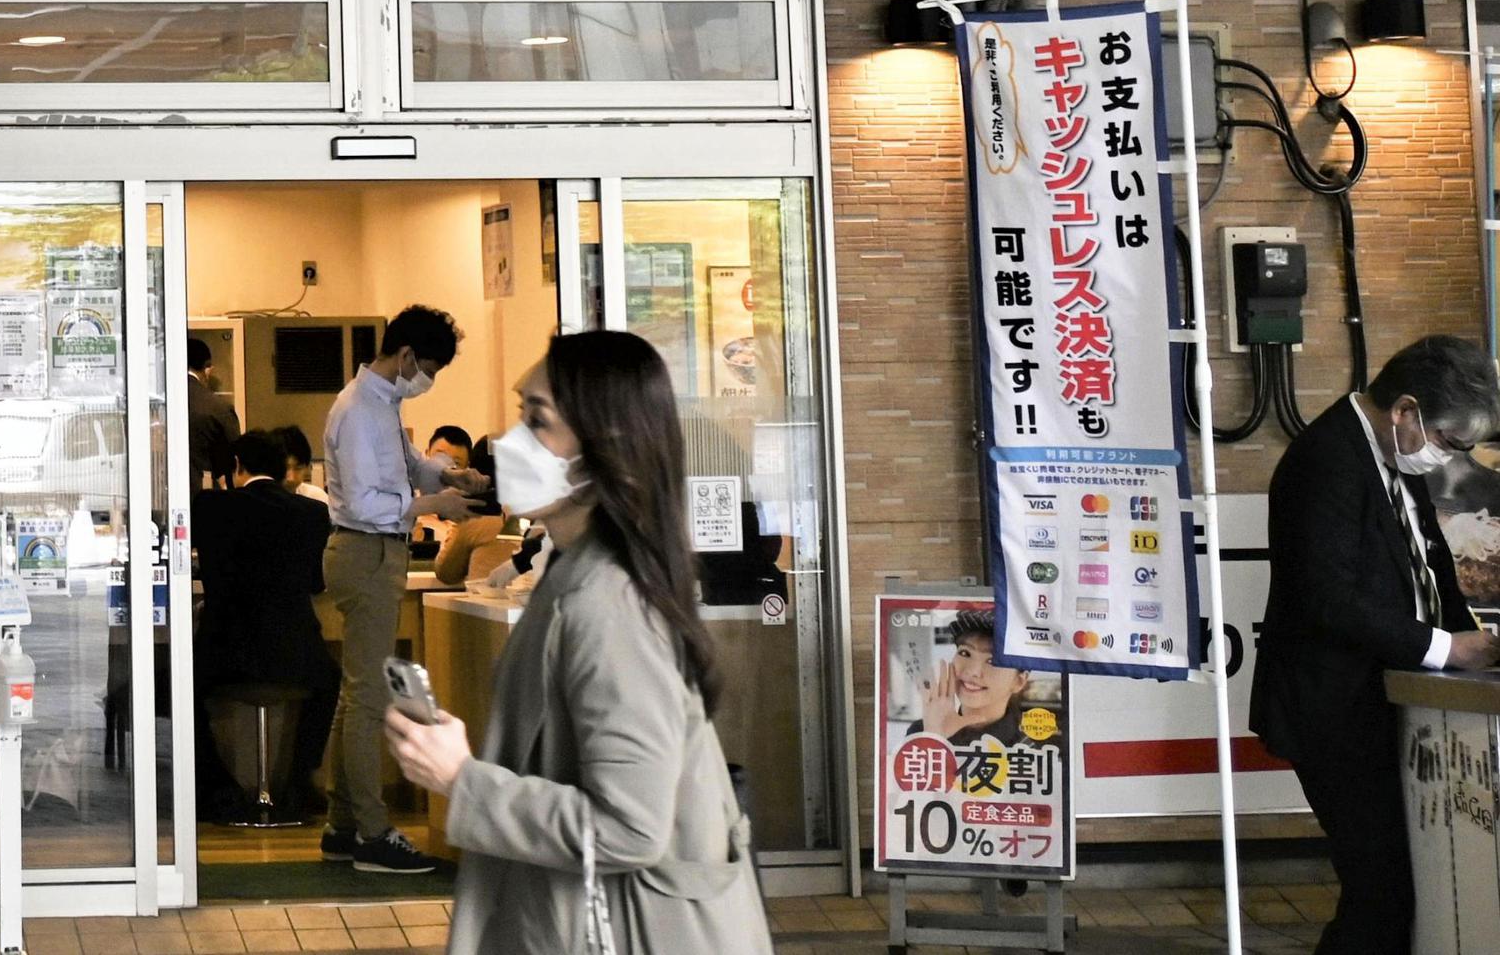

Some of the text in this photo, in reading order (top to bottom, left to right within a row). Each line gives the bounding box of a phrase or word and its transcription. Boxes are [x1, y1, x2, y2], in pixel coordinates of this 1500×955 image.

[1099, 31, 1149, 250] お支払いは
[1034, 36, 1117, 437] キャッシュレス決済も
[1046, 449, 1138, 462] 利用可能ブランド
[1028, 500, 1054, 510] VISA
[1133, 534, 1158, 550] iD
[1038, 594, 1047, 608] R
[1035, 611, 1049, 620] Edy
[1029, 632, 1049, 642] VISA
[966, 804, 1035, 824] 定食全品
